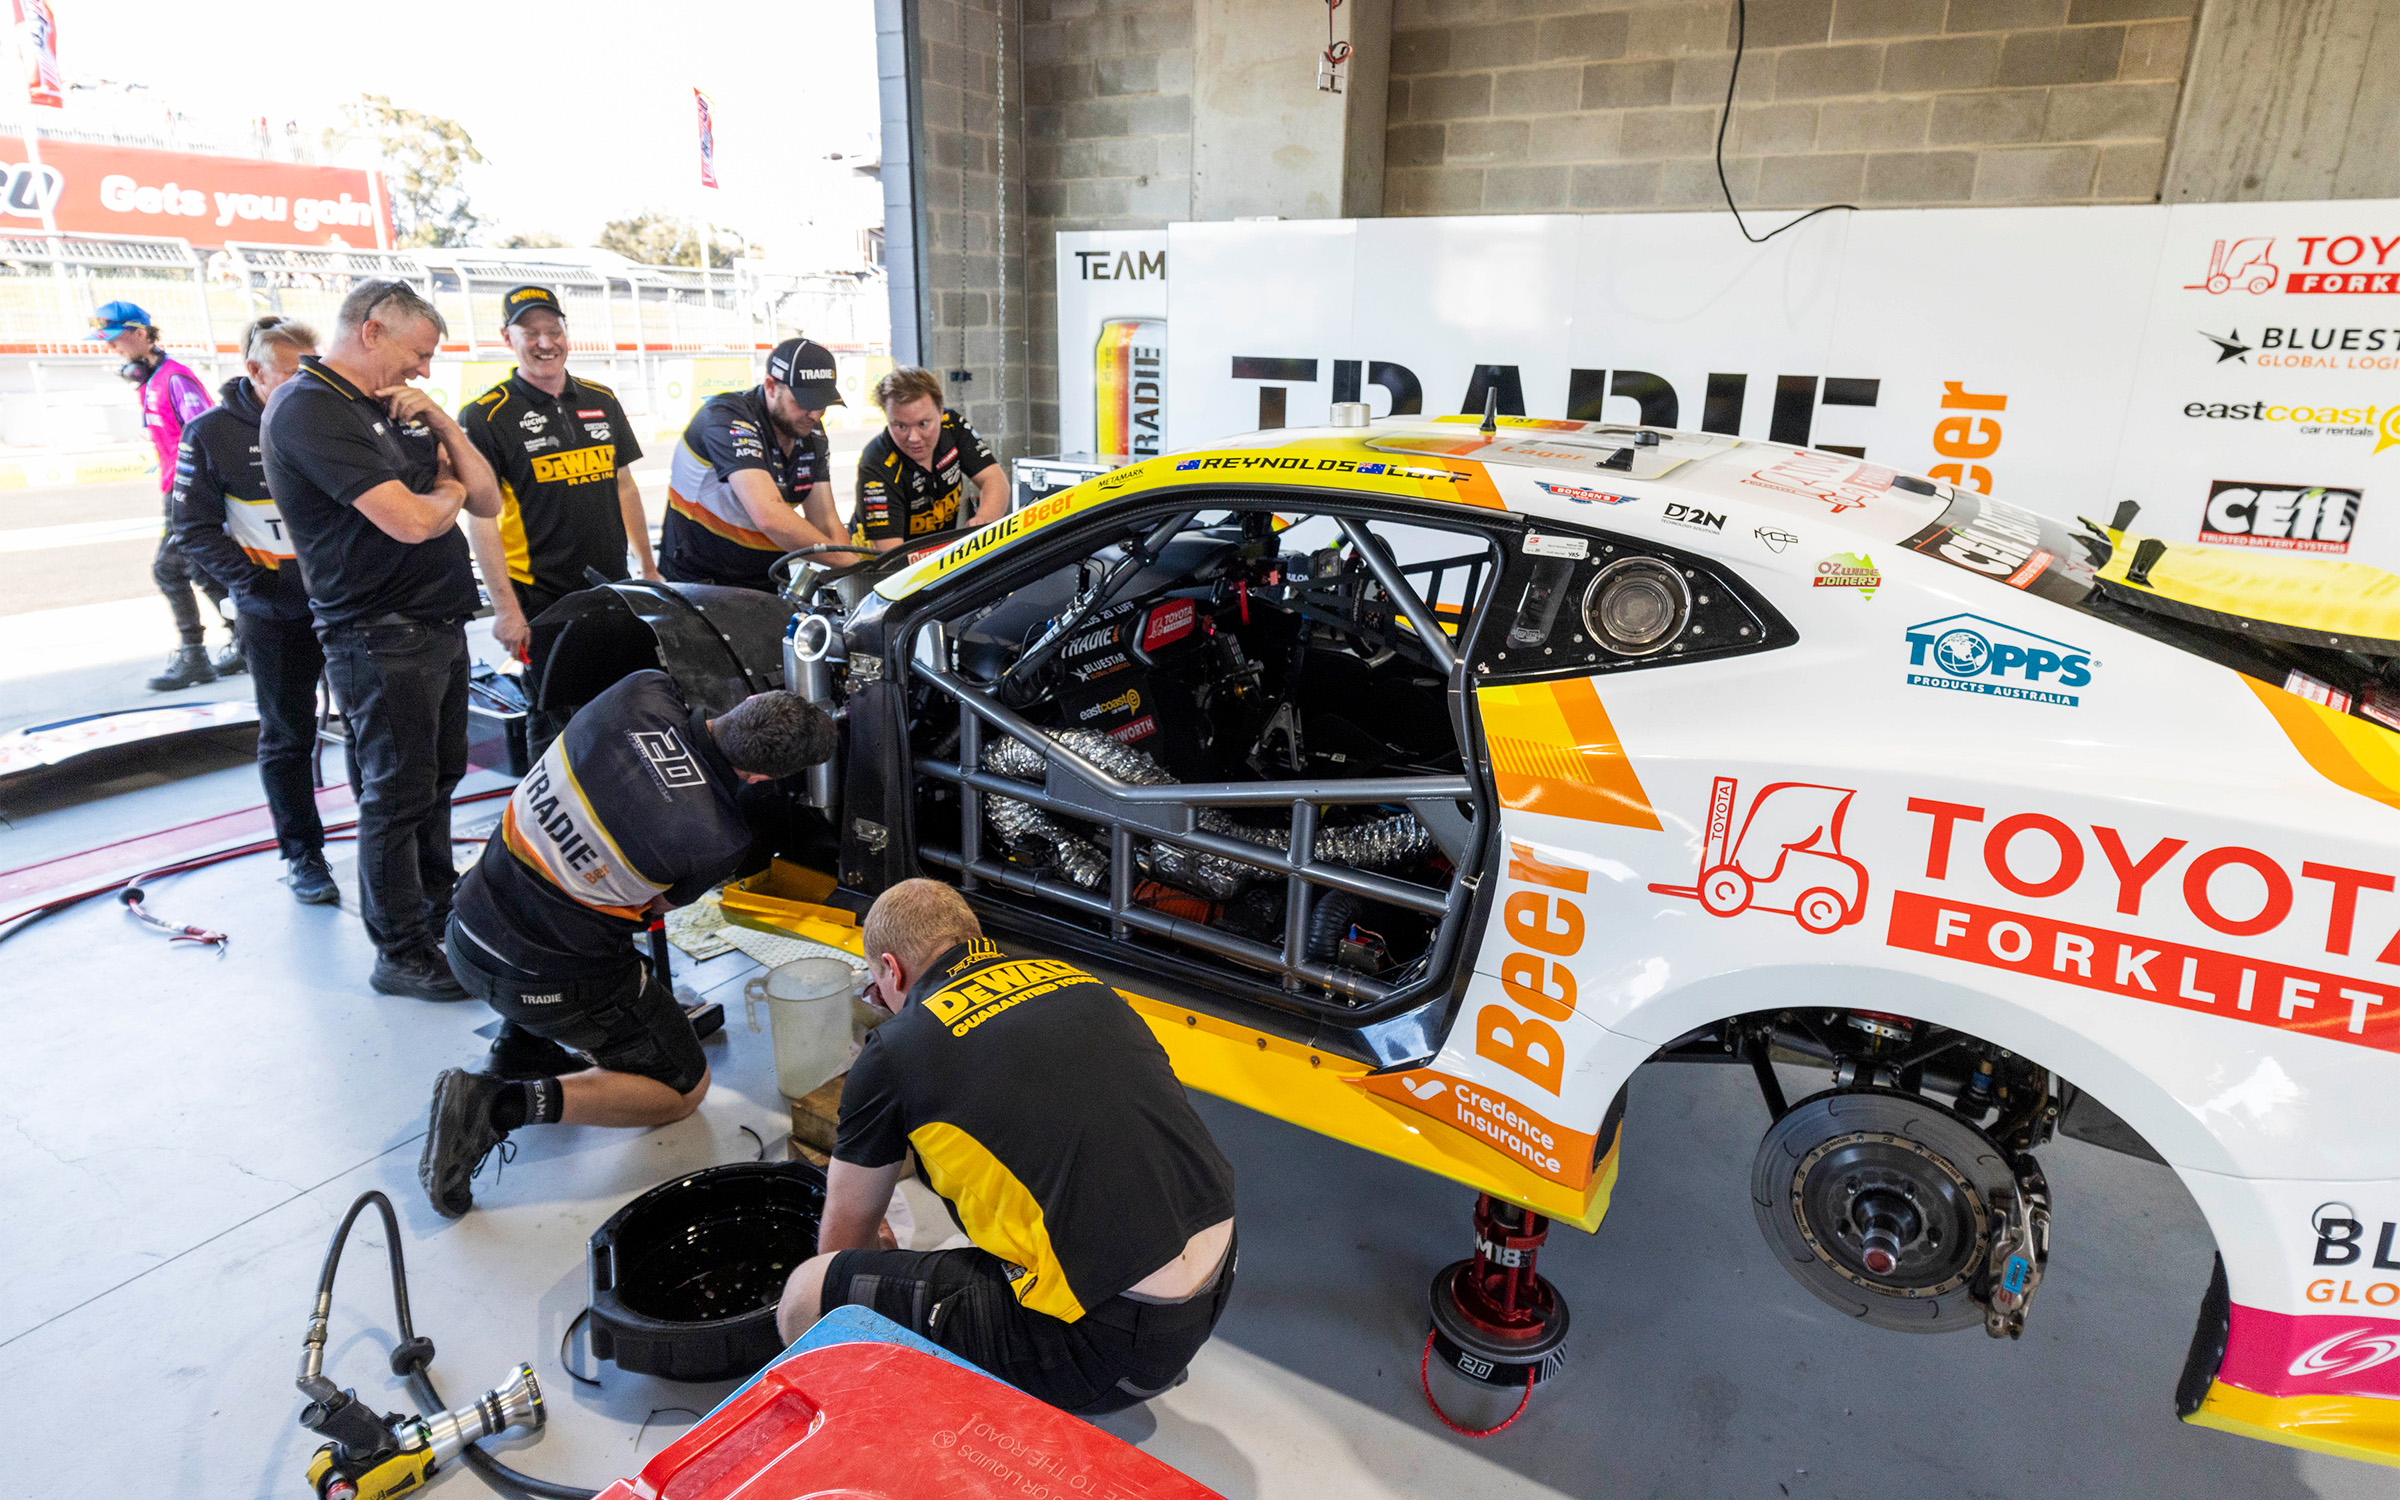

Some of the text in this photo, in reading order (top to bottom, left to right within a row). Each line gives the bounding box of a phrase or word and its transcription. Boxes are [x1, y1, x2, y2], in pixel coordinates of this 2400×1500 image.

[100, 174, 207, 217] Gets
[213, 191, 288, 227] you
[293, 193, 373, 232] goin
[1075, 251, 1165, 280] TEAM
[799, 368, 833, 381] TRADIE
[2257, 354, 2338, 369] GLOBAL
[1133, 347, 1160, 463] RADIE
[2183, 400, 2380, 426] eastcoast
[1926, 380, 2008, 496] eer
[2300, 426, 2375, 438] car rentals
[567, 471, 615, 487] RACIN
[1097, 467, 1145, 488] METAMARK
[1201, 456, 1357, 472] REYNOLDS
[937, 513, 1020, 570] TRADIE
[1022, 492, 1075, 529] Beer
[2206, 487, 2352, 543] CEIL
[2201, 532, 2347, 554] TRUSTED BATTERY SYSTEMS
[1816, 576, 1878, 587] JOINERY
[1115, 600, 1135, 615] LUFF
[1164, 605, 1193, 623] TOYOTA
[1083, 652, 1128, 674] BLUESTAR
[1905, 628, 2092, 688] TOPPS
[1079, 692, 1128, 721] eastcoast
[1913, 676, 2071, 706] PRODUCTS AUSTRALIA
[1108, 720, 1155, 746] NWORTH
[631, 725, 707, 789] 20
[526, 758, 598, 872] TRADIE
[1710, 783, 1733, 842] TOYOTA
[1905, 795, 2400, 966] TOYOT
[1475, 841, 1590, 1099] Beer
[1933, 908, 2385, 1036] FORKLIFT
[520, 993, 563, 1005] TRADIE
[923, 960, 1089, 1025] DEWALT
[951, 981, 1059, 1038] GUARANTEED
[532, 1079, 547, 1117] TEAM
[1453, 1083, 1555, 1152] Credence
[1456, 1103, 1561, 1175] Insurance
[2313, 1217, 2400, 1271] BL
[1456, 1351, 1495, 1380] 20
[956, 1445, 1026, 1487] LIQUIDS
[973, 1422, 1098, 1498] TO THE ROAD
